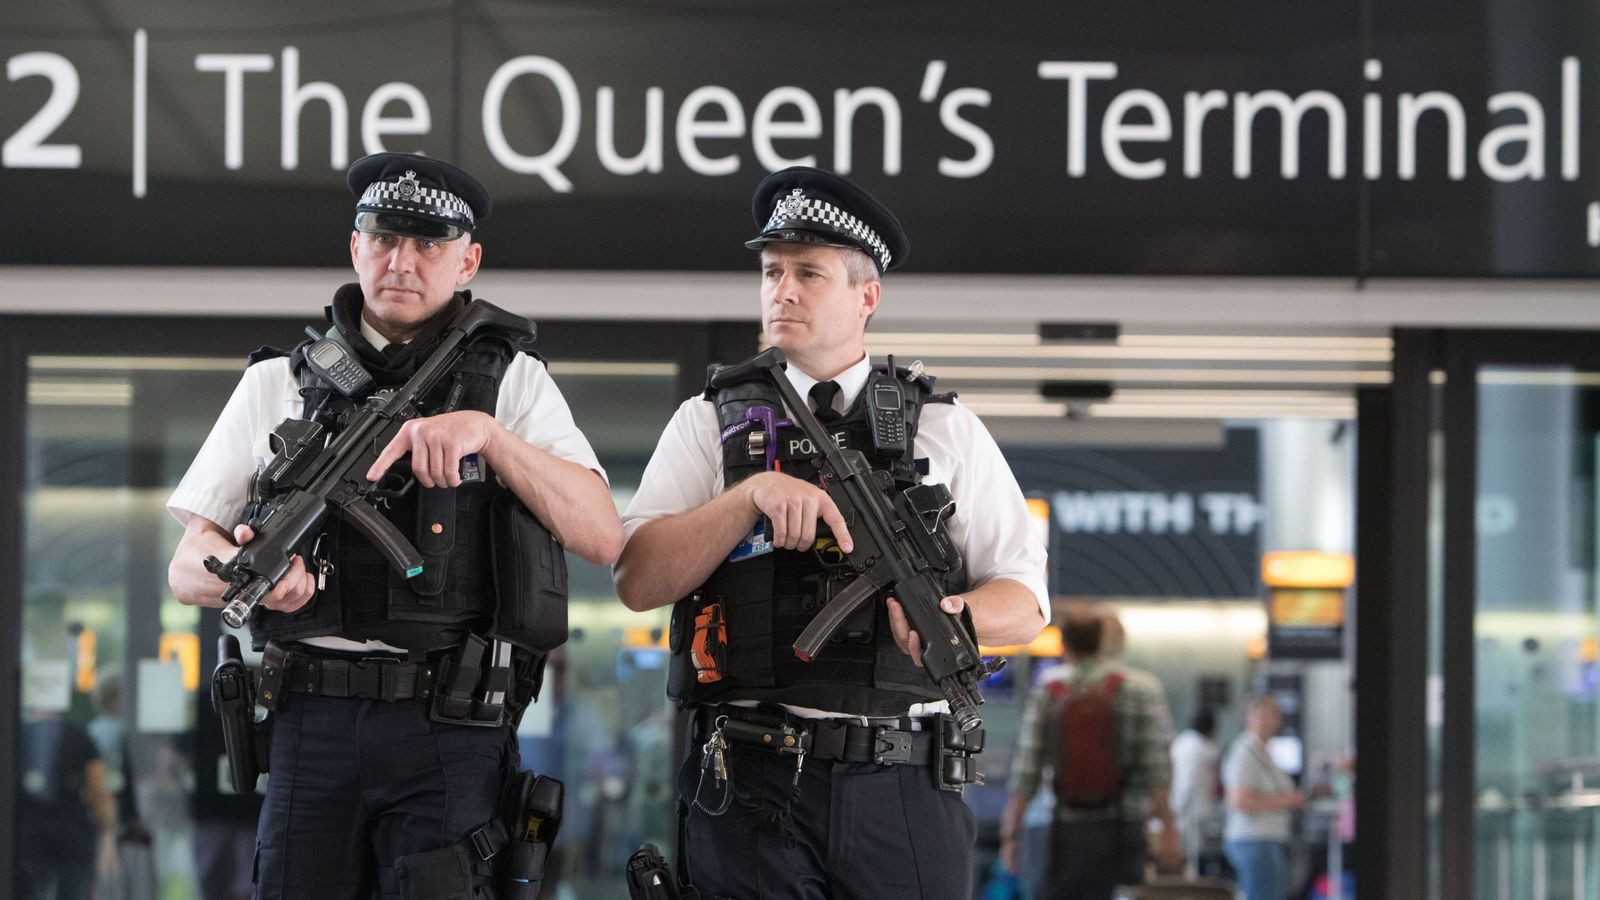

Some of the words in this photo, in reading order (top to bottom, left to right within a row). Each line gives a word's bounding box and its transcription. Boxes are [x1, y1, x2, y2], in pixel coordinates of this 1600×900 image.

[2, 52, 81, 169] 2
[195, 47, 432, 171] The
[482, 56, 994, 191] Queen's
[1038, 57, 1580, 181] Terminal
[1053, 491, 1194, 534] WITH
